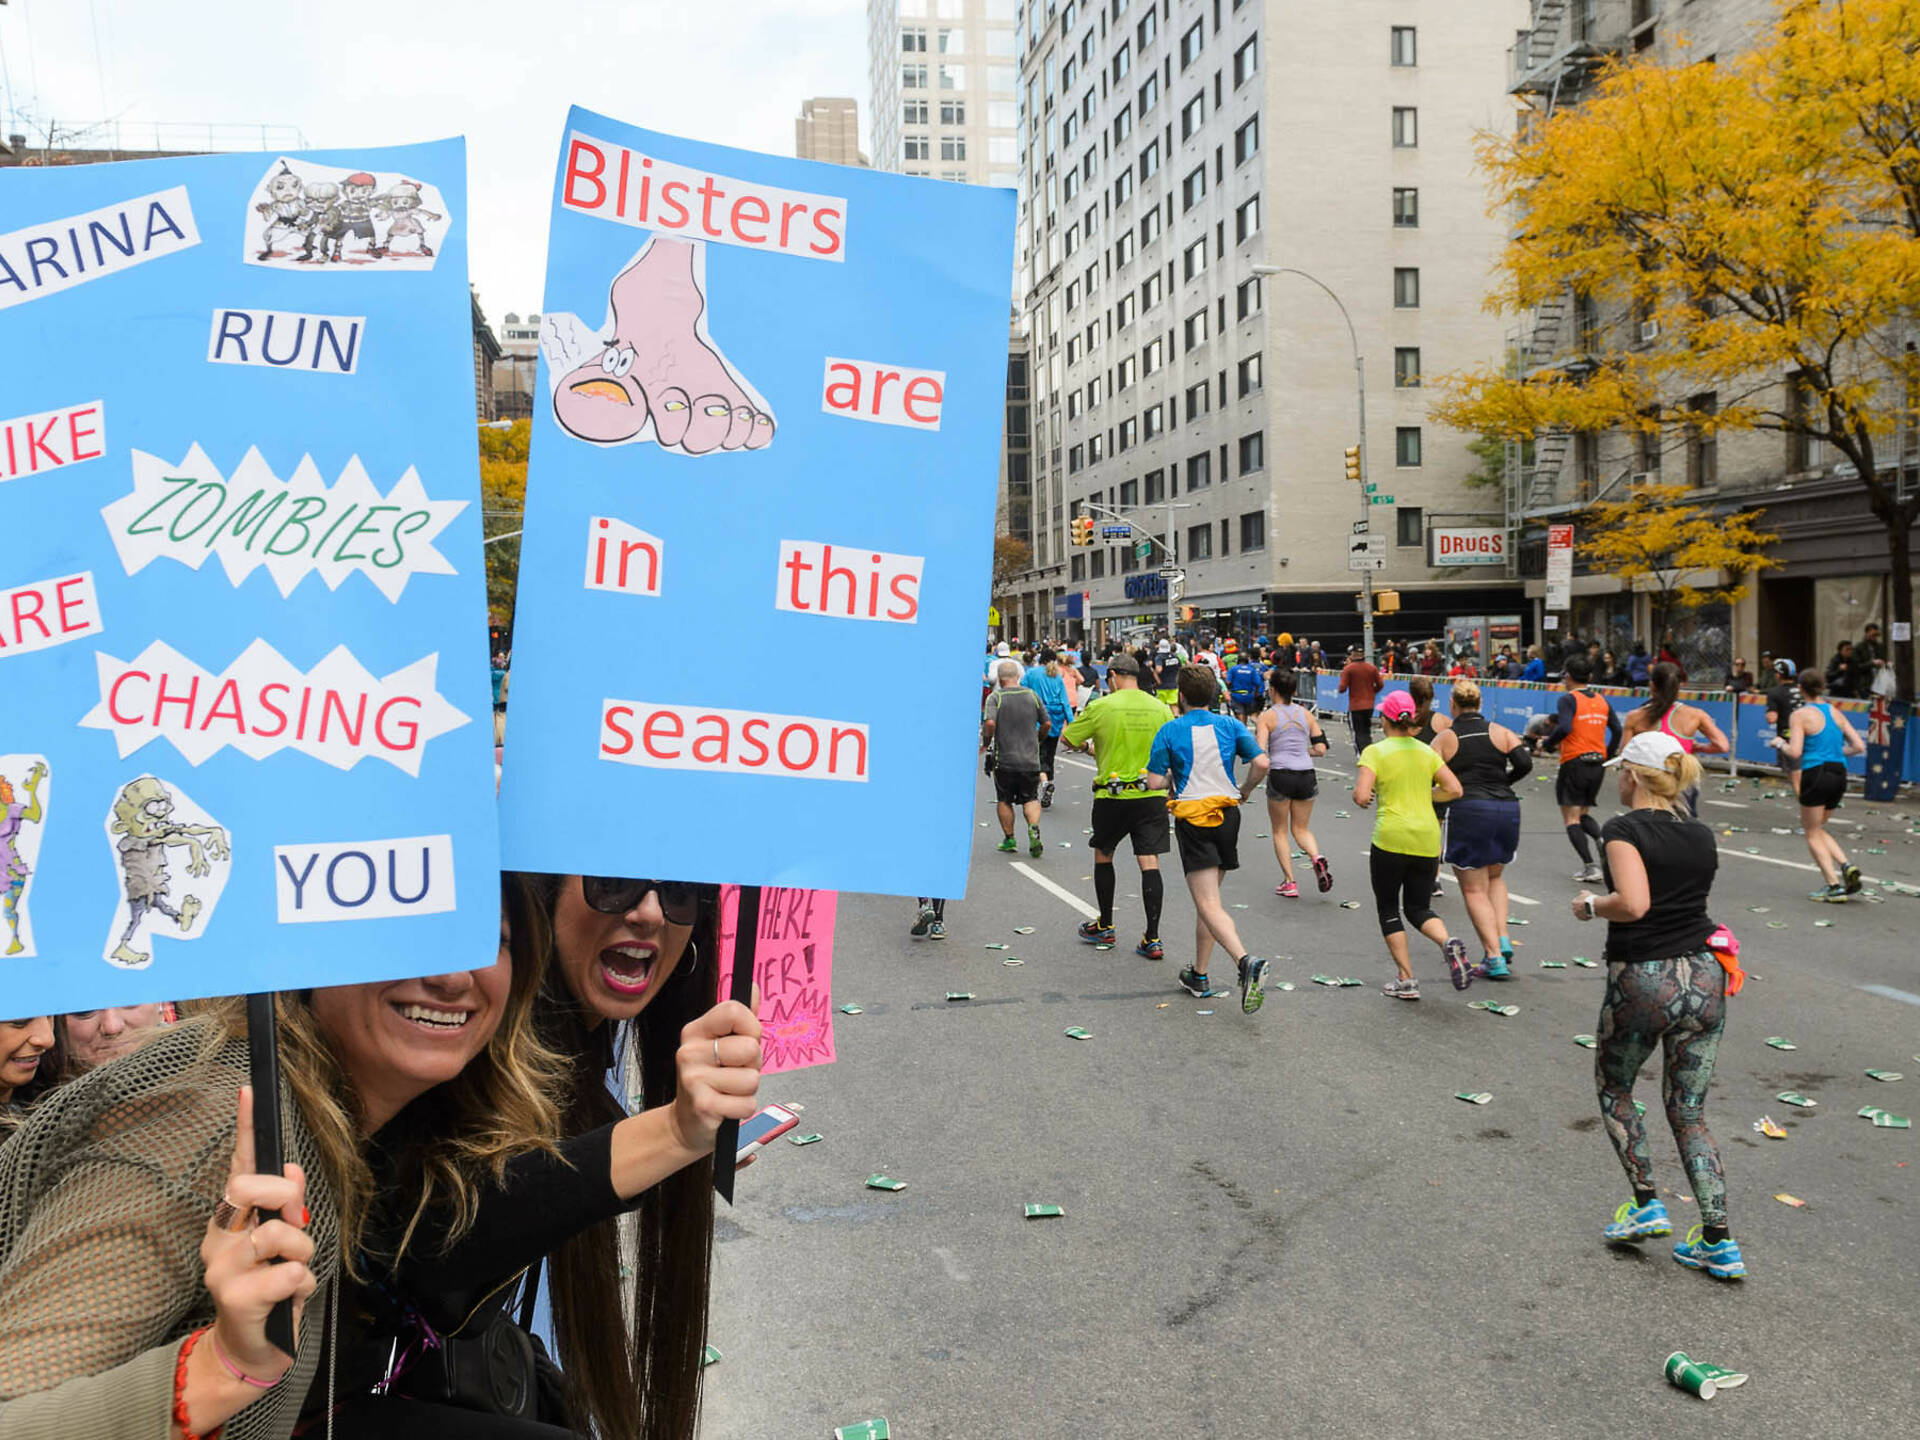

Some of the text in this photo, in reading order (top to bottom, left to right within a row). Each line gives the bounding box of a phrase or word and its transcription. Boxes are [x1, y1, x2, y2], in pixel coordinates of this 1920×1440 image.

[563, 139, 841, 255] Blisters
[214, 310, 359, 373] RUN
[825, 361, 944, 424] are
[0, 408, 102, 478] IKE
[127, 476, 431, 569] ZOMBIES
[1440, 534, 1503, 554] DRUGS
[594, 518, 919, 620] in this
[0, 577, 91, 648] RE
[108, 669, 423, 751] CHASING
[601, 704, 867, 777] season
[278, 847, 430, 910] YOU
